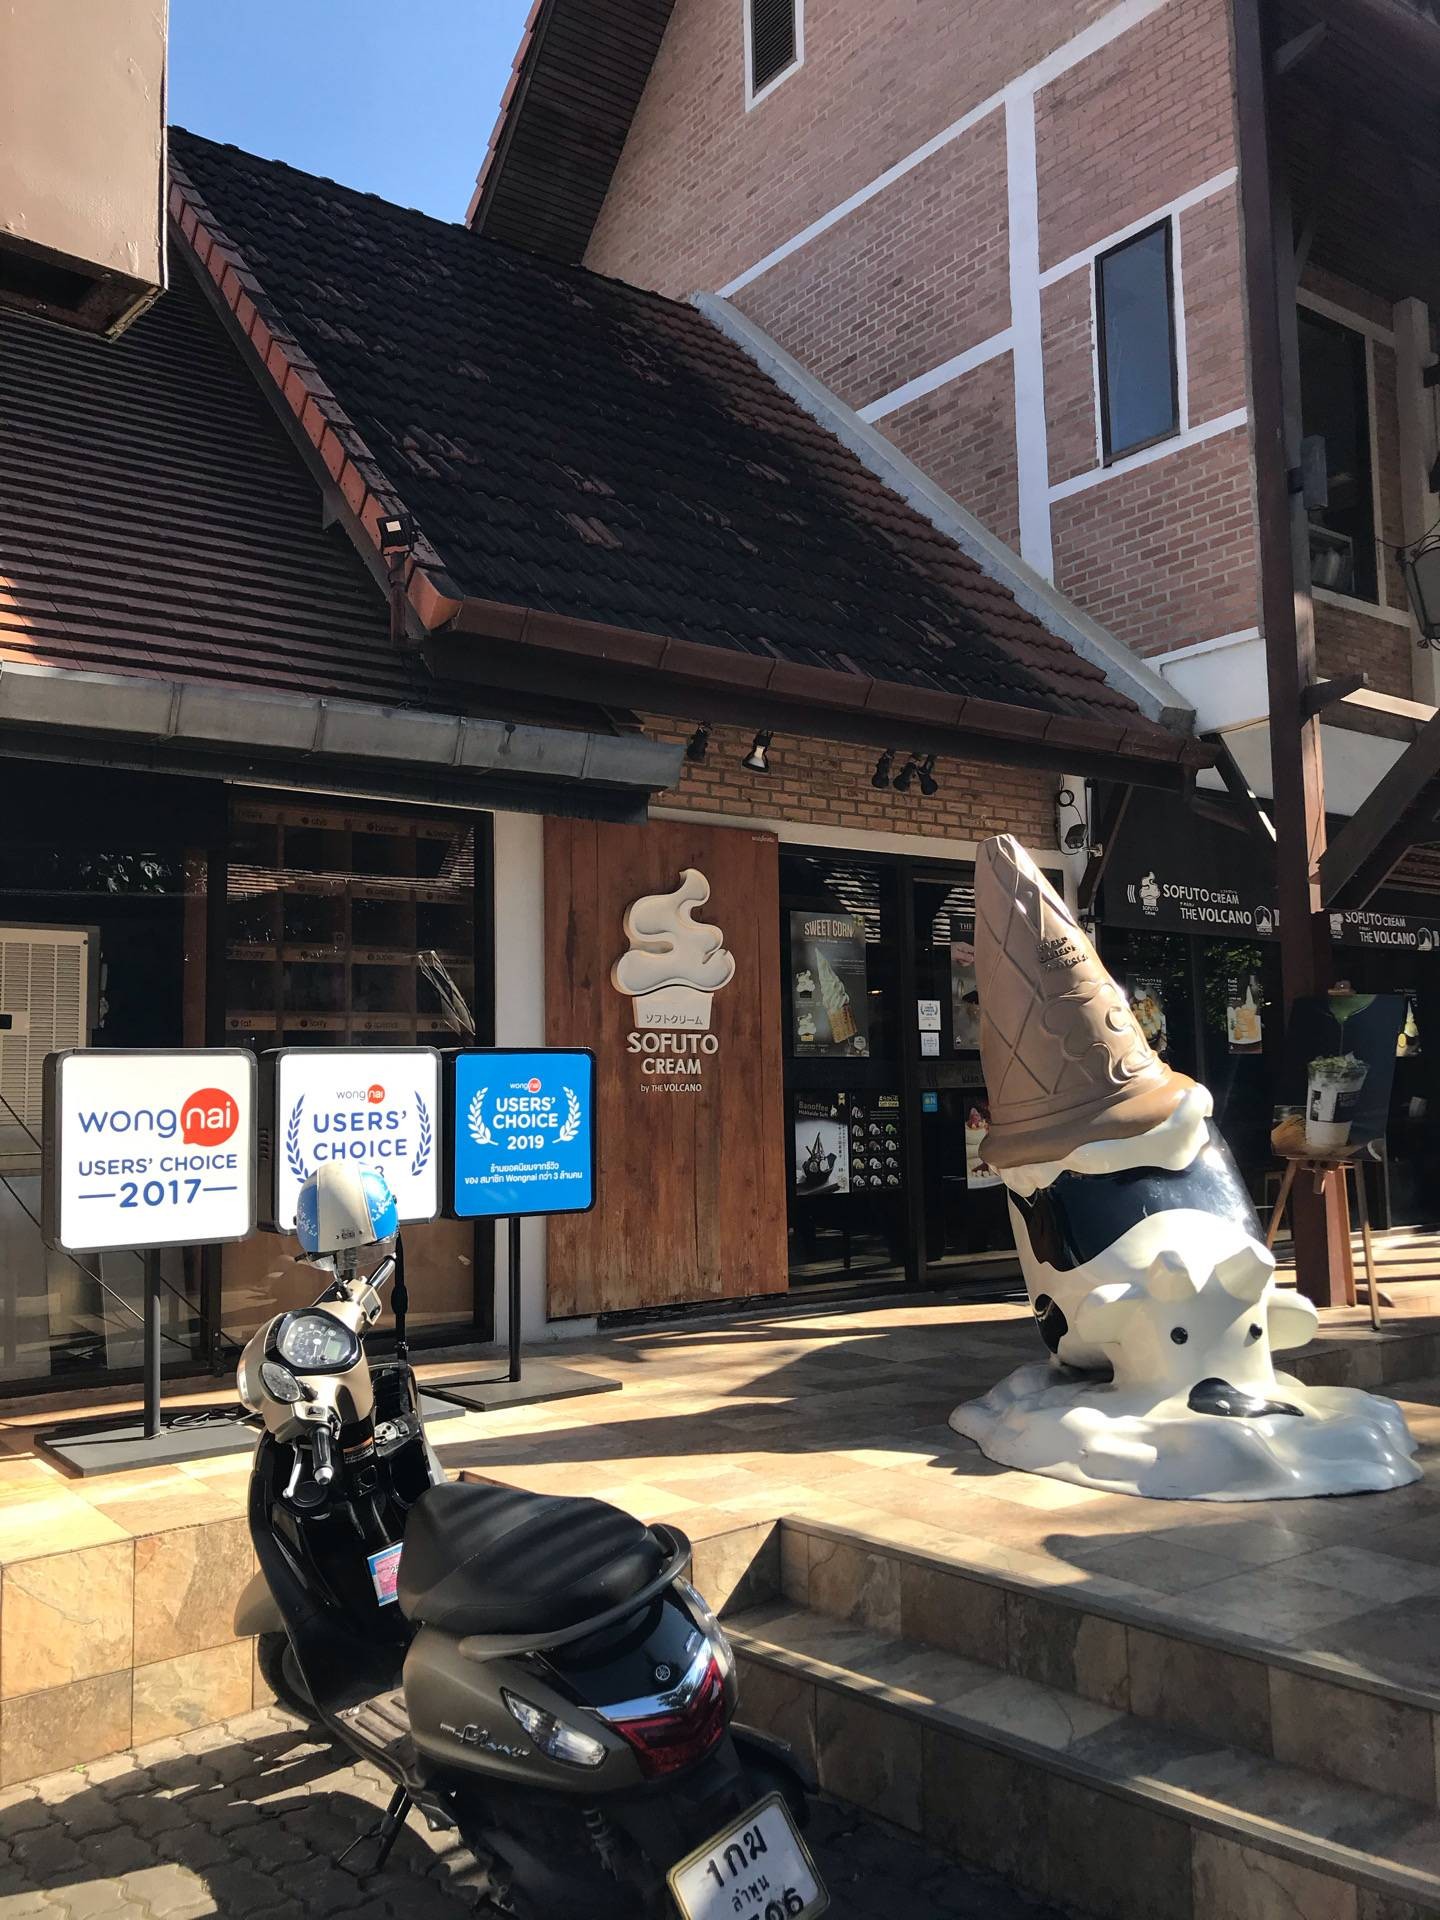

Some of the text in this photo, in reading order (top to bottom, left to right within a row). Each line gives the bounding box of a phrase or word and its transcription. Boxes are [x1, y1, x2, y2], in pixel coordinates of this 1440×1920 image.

[1163, 884, 1239, 905] SOFUTO CREAM
[1180, 907, 1252, 925] THE VOLCANO
[1345, 912, 1406, 927] SOFUTO CREAM
[804, 919, 853, 938] SWEET CORN
[1360, 931, 1416, 945] THE VOLCANO
[646, 1014, 703, 1025] ソフトクリーム
[626, 1032, 719, 1055] SOFUTO
[641, 1058, 702, 1075] CREAM
[641, 1083, 702, 1093] by THE VOLCANO
[492, 1112, 559, 1129] CHOICE
[313, 1138, 408, 1161] CHOICE
[507, 1134, 545, 1150] 2019
[160, 1154, 238, 1172] CHOICE
[505, 1173, 538, 1184] Wongnai
[119, 1178, 202, 1208] 2017
[731, 1874, 770, 1912] ลำพูน
